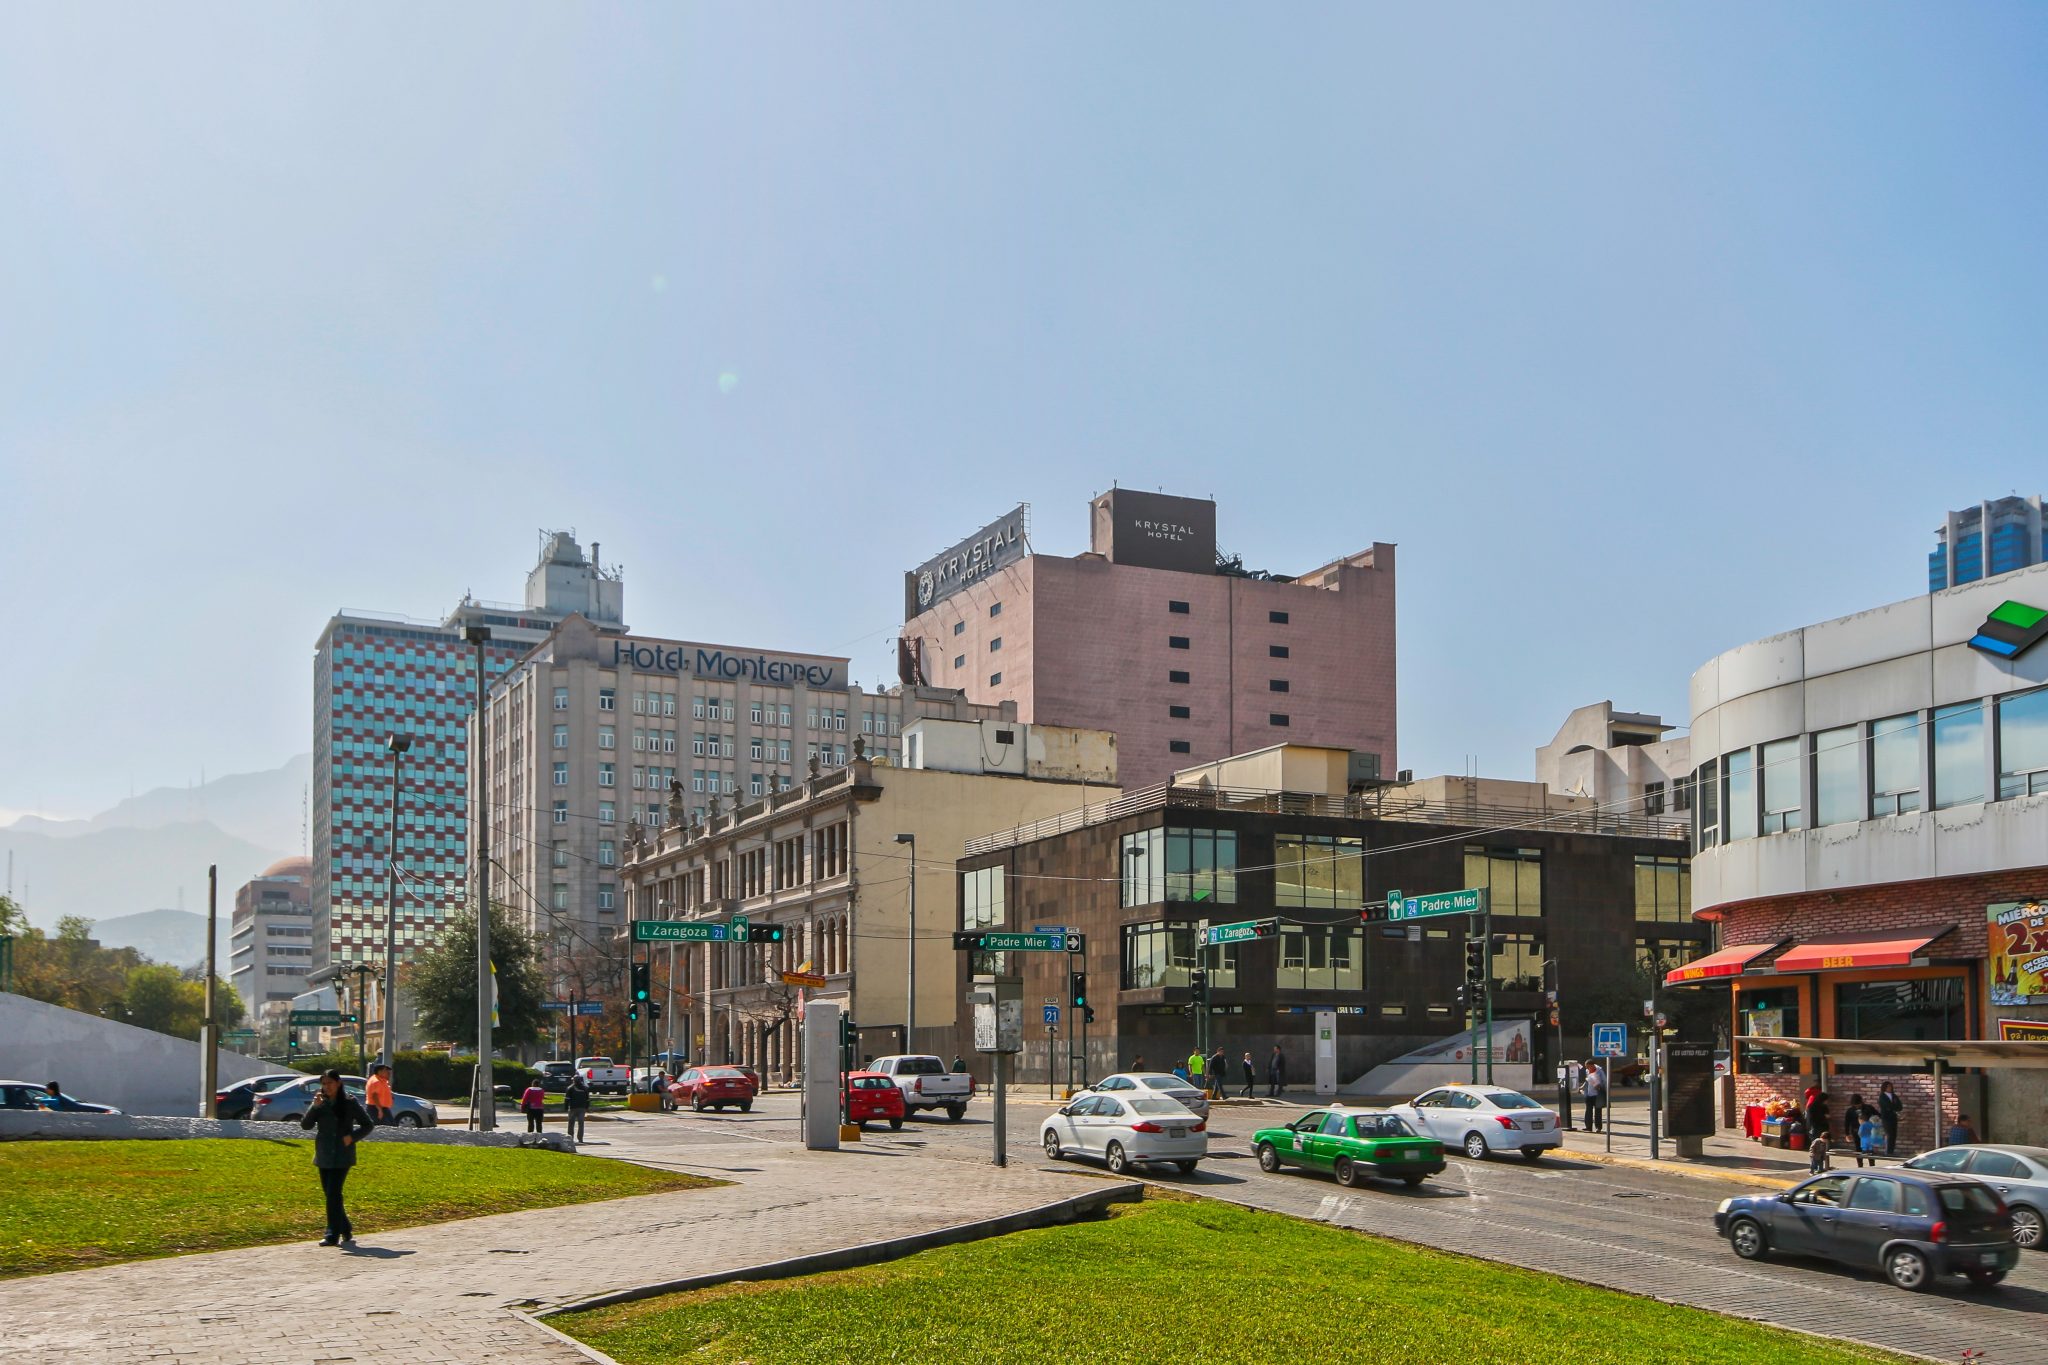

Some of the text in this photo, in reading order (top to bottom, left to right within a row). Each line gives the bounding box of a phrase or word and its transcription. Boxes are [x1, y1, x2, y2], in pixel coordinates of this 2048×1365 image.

[1135, 519, 1194, 535] KRYSTAL
[1147, 530, 1183, 541] HOTEL
[938, 524, 1016, 582] KRYSTAL
[960, 558, 994, 583] HOTEL
[614, 640, 833, 686] Hotel Monterrey
[1408, 896, 1477, 915] 24 Padre Mier
[2030, 917, 2044, 927] DE
[642, 926, 724, 938] I. Zaragoza 21
[1224, 927, 1254, 939] Zaragoza
[990, 936, 1060, 949] Padre Mier 24
[1822, 956, 1854, 968] BEER
[1683, 967, 1705, 980] WINGS
[1046, 1011, 1057, 1022] 21
